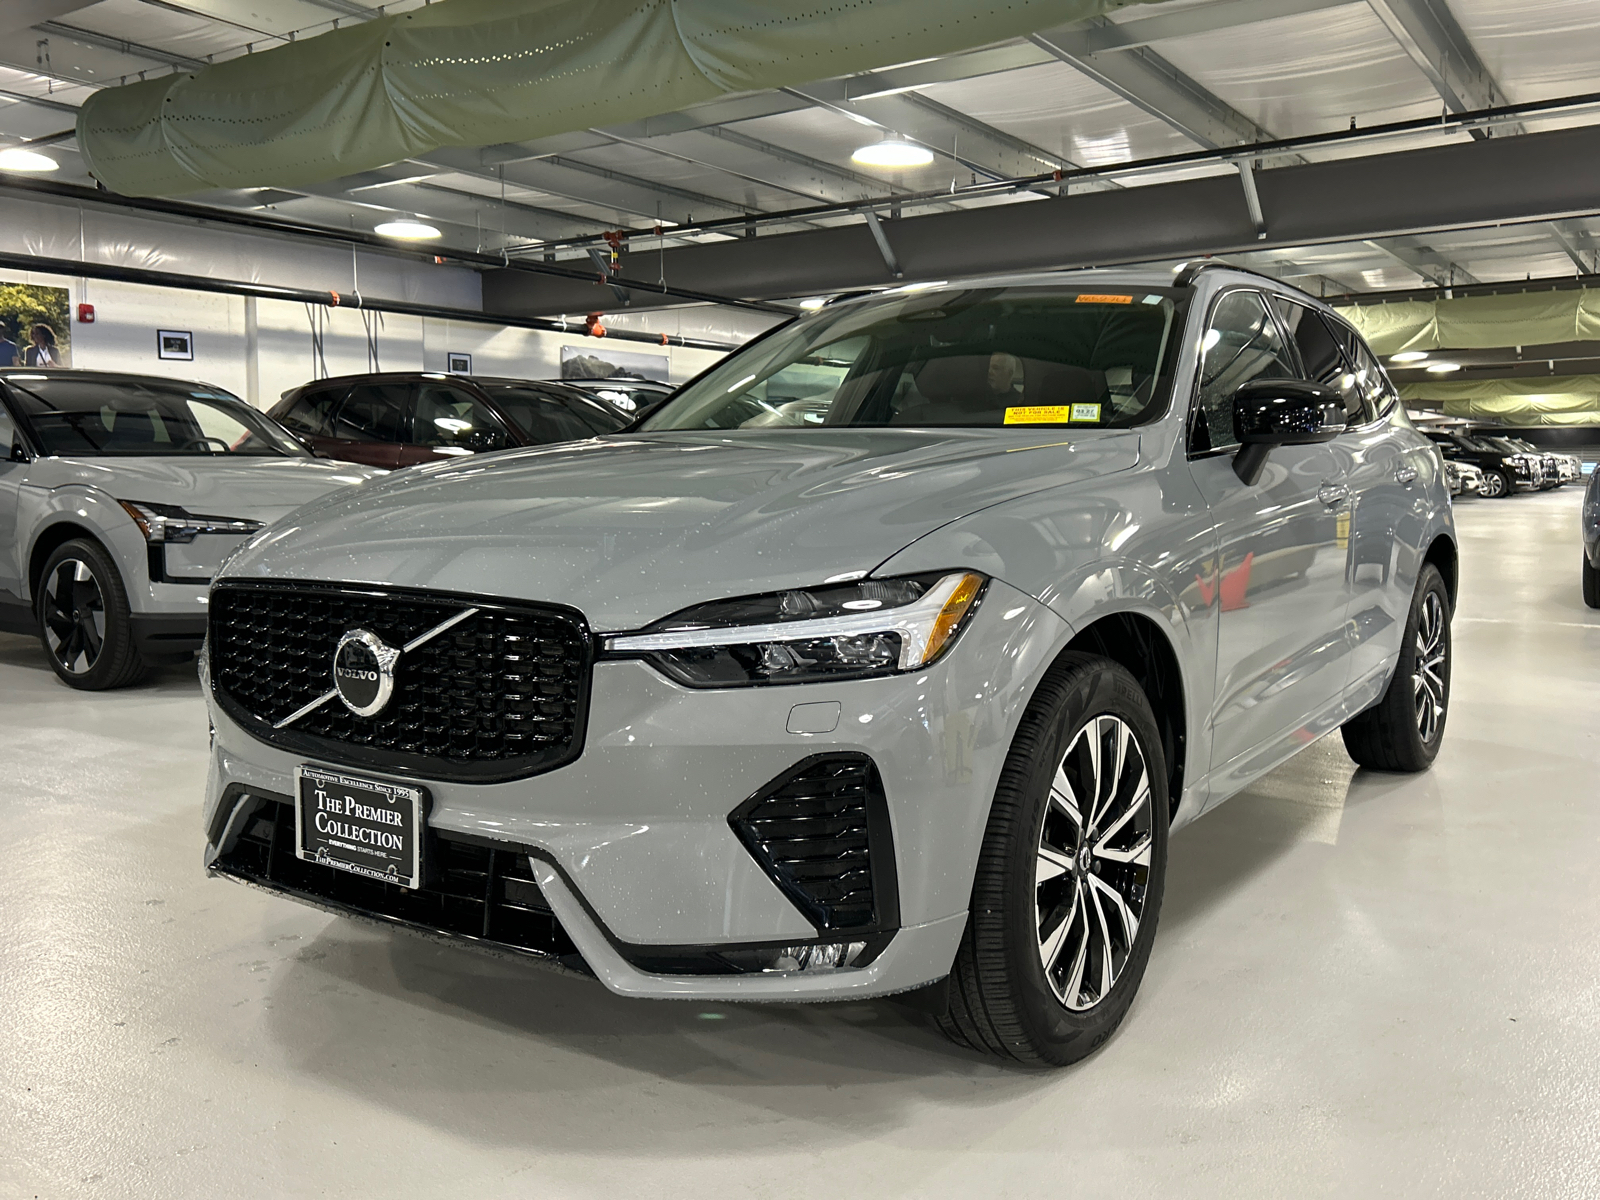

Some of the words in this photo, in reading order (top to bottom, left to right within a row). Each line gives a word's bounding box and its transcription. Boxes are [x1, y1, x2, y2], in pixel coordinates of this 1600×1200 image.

[338, 667, 378, 680] VOLVO
[303, 770, 338, 782] AUTOMOTIVE
[340, 776, 373, 789] EXCELLENCE
[374, 784, 392, 794] SINCE
[394, 788, 409, 797] 1995
[314, 789, 342, 814] THE
[344, 796, 402, 826] PREMIER
[315, 812, 402, 850] COLLECTION
[328, 839, 356, 851] EVERYTHING
[357, 846, 374, 855] STARTS
